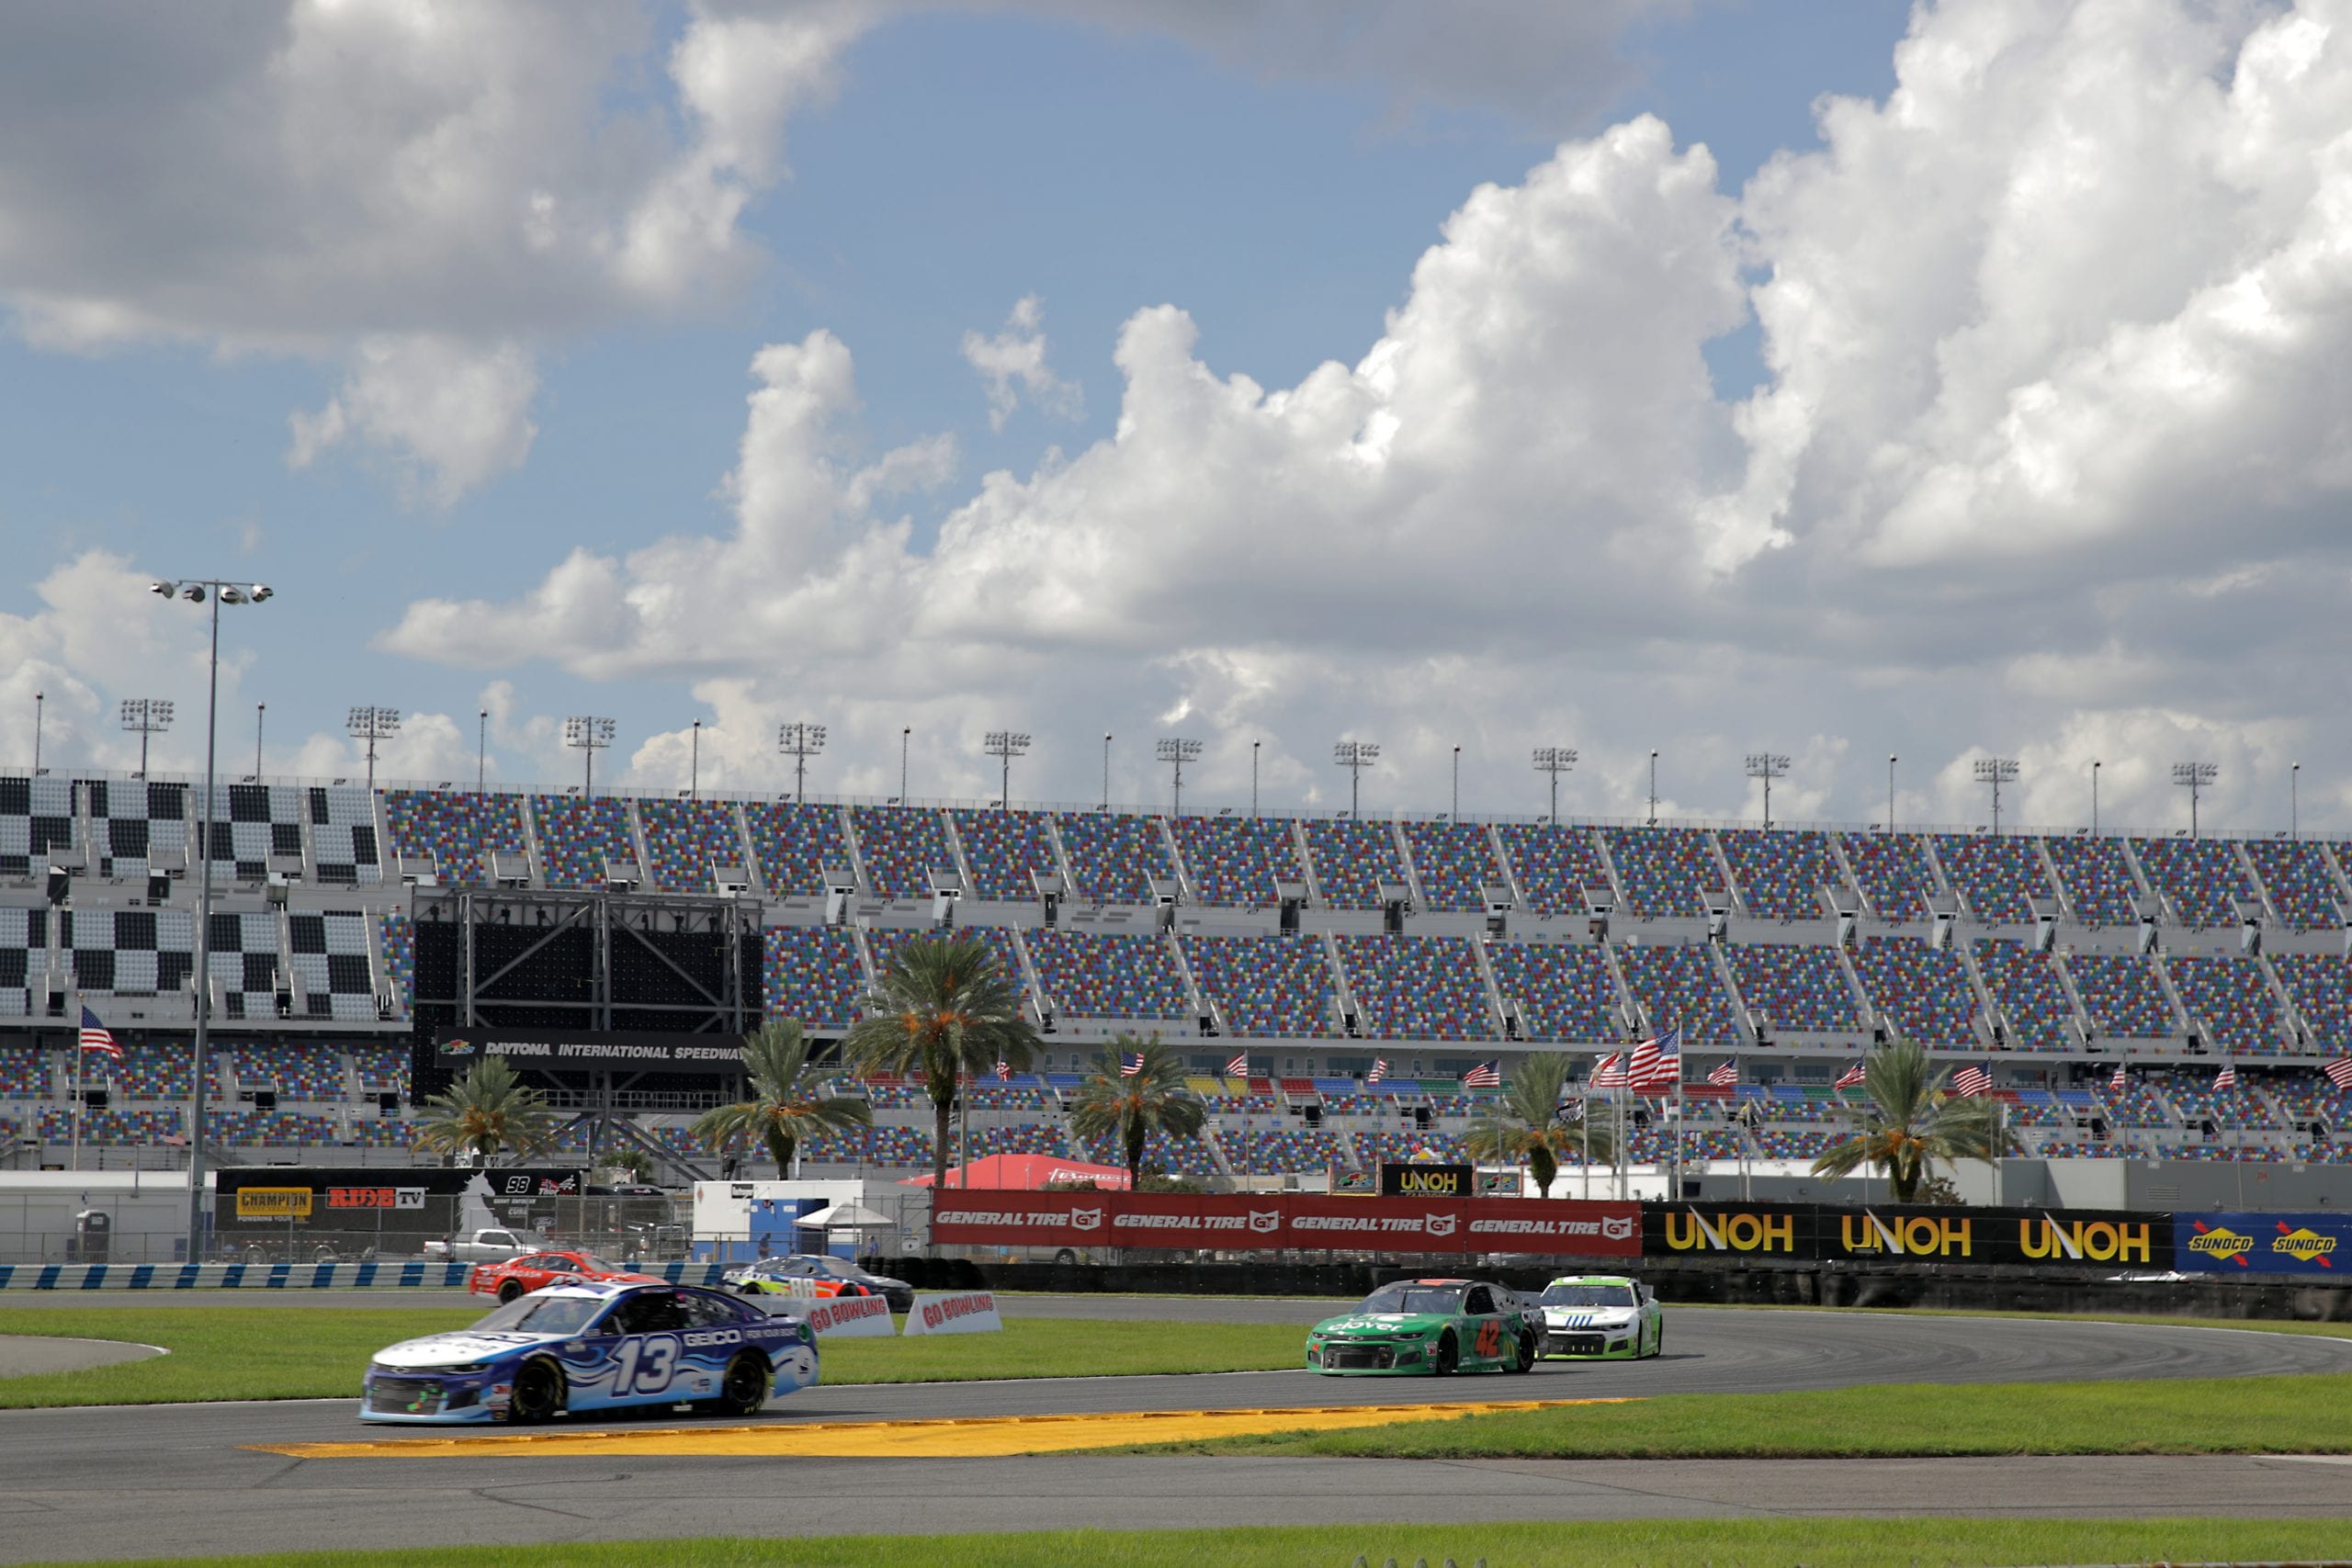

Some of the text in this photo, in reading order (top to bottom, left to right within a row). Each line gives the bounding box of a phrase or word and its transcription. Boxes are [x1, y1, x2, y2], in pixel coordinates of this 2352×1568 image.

[485, 1042, 551, 1055] DAYTONA
[558, 1043, 670, 1058] INTERNATIONAL
[505, 1176, 531, 1193] 98
[1400, 1170, 1458, 1190] UNOH
[328, 1189, 423, 1207] RIDE TV
[936, 1211, 1023, 1225] GENERAL
[1027, 1213, 1069, 1226] TIRE
[1114, 1213, 1201, 1228] GENERAL
[1204, 1216, 1247, 1229] TIRE
[1292, 1216, 1378, 1231] GENERAL
[1381, 1218, 1423, 1232] TIRE
[1470, 1220, 1556, 1234] GENERAL
[1558, 1222, 1600, 1235] TIRE
[1666, 1205, 1792, 1251] UNOH
[1842, 1208, 1971, 1256] UNOH
[2020, 1212, 2150, 1262] UNOH
[2192, 1237, 2251, 1249] SUNOCO
[2276, 1238, 2334, 1250] SUNOCO
[809, 1299, 887, 1332] GO BOWLING
[922, 1295, 994, 1328] GO BOWLING
[1328, 1321, 1403, 1332] clover
[683, 1329, 742, 1347] GEICO
[1476, 1319, 1500, 1357] 42
[606, 1332, 683, 1398] 13
